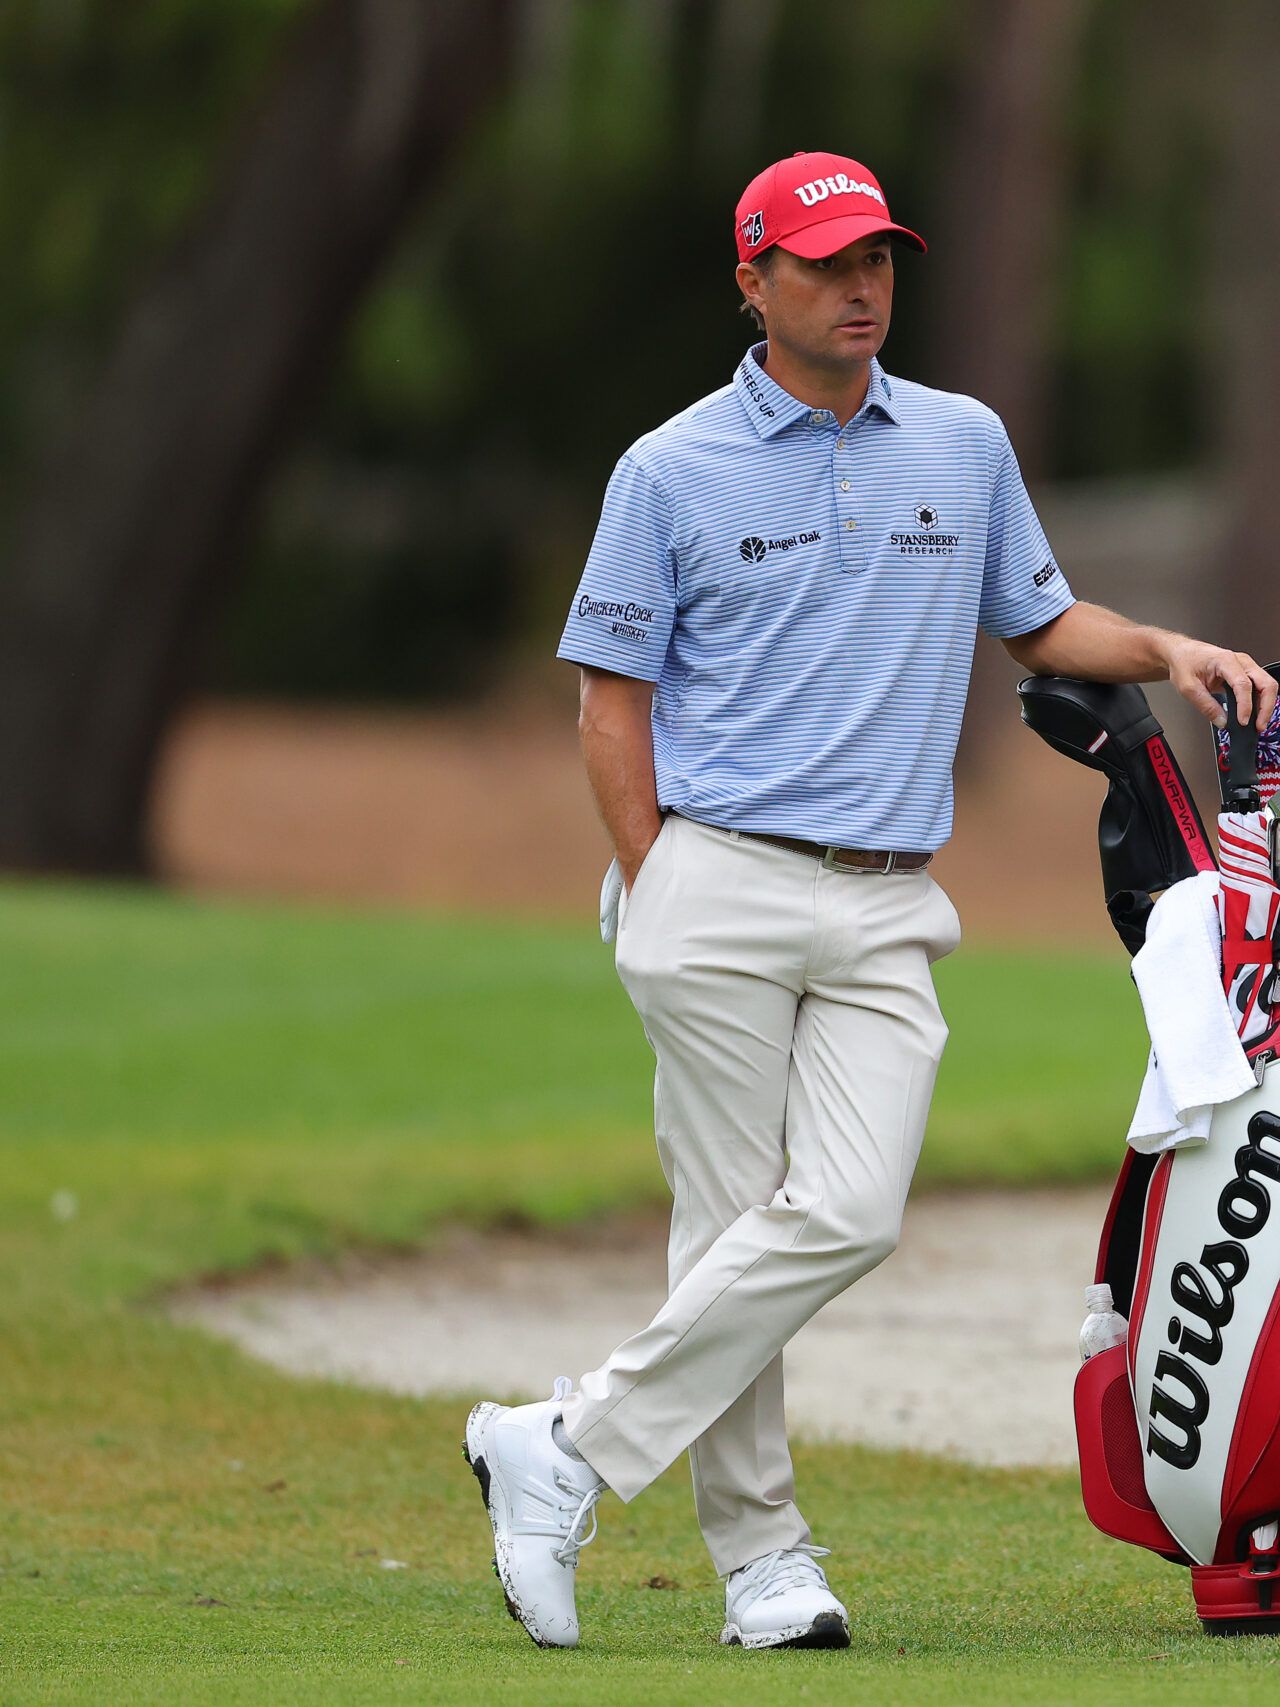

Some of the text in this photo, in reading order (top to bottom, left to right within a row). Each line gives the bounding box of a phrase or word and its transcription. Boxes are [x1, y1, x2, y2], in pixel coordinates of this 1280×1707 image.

[794, 173, 886, 207] Wilson
[740, 360, 775, 418] WHEELS UP
[768, 530, 821, 551] Angel Oak
[890, 534, 960, 547] STANSBERRY
[900, 546, 953, 556] RESEARCH
